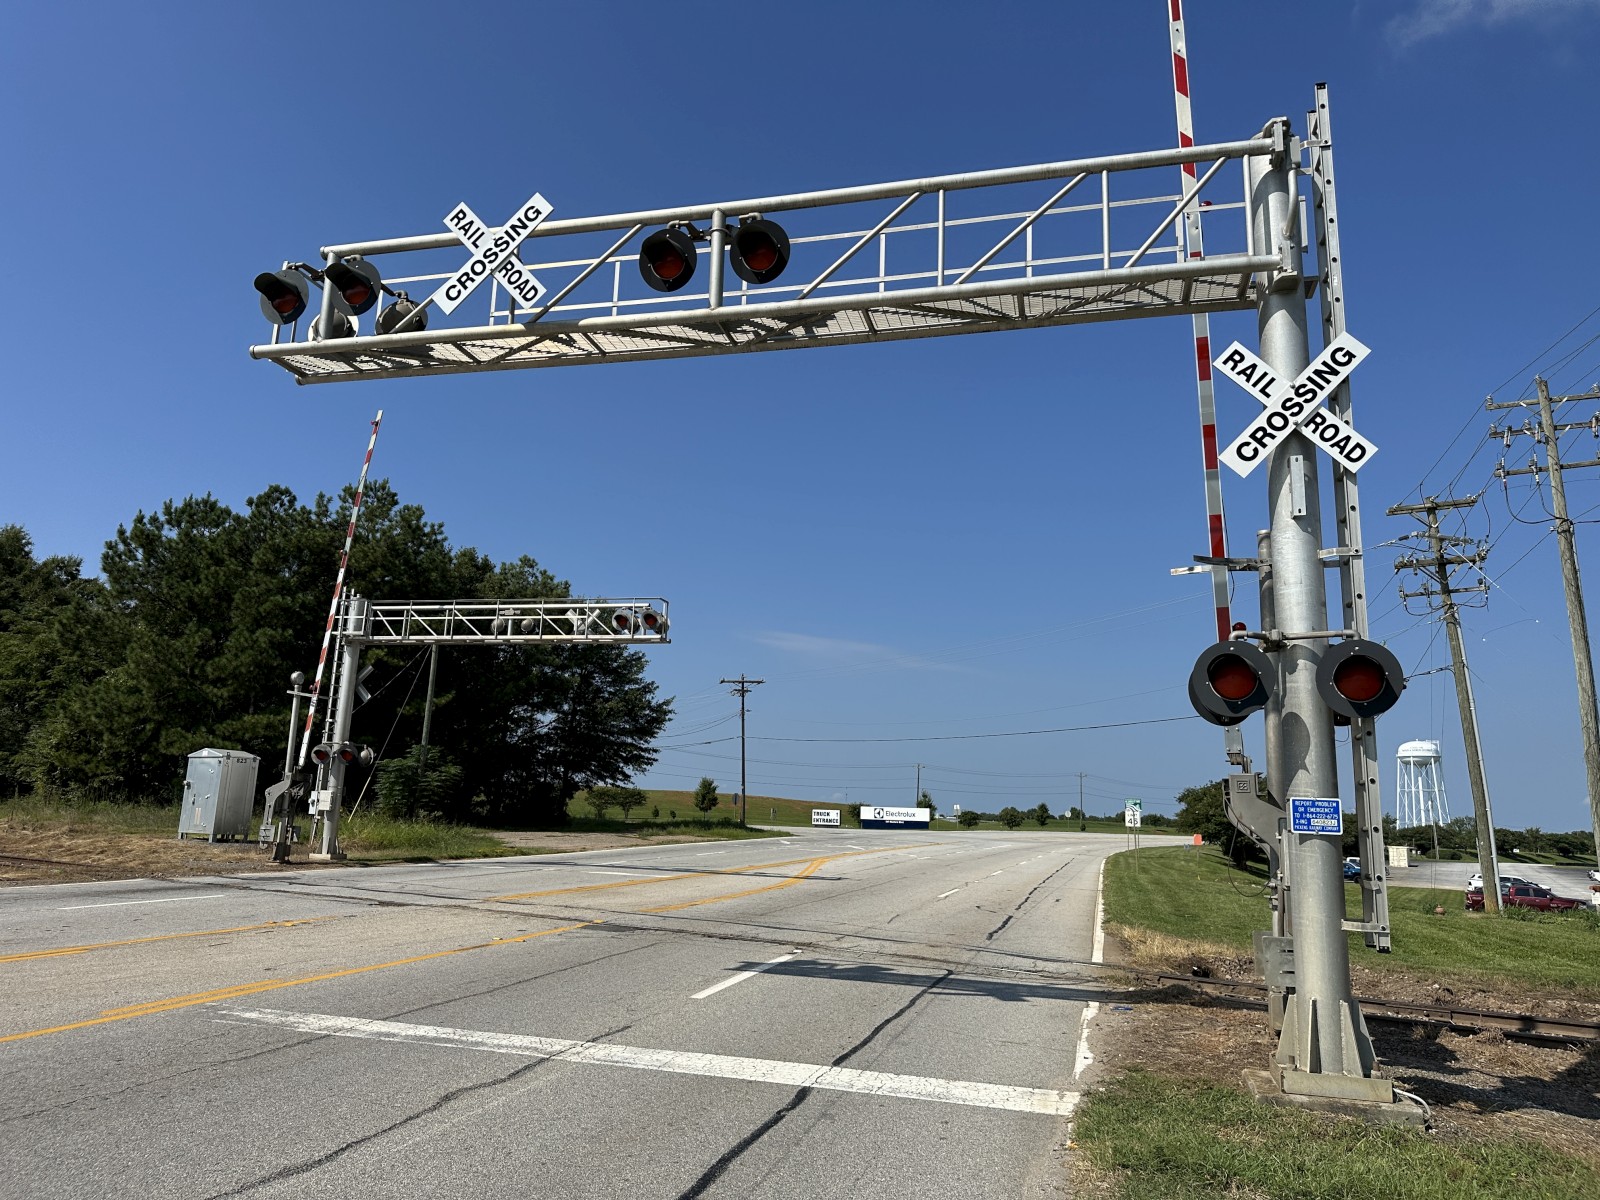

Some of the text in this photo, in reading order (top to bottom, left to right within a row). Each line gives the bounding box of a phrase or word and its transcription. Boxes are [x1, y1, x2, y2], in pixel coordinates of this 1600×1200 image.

[445, 205, 543, 302] CROSSING
[449, 208, 485, 249] RAIL
[498, 260, 539, 302] ROAD
[1222, 349, 1276, 399] RAIL
[1236, 346, 1357, 462] CROSSING
[1303, 411, 1367, 463] ROAD
[885, 810, 916, 818] Electrolux
